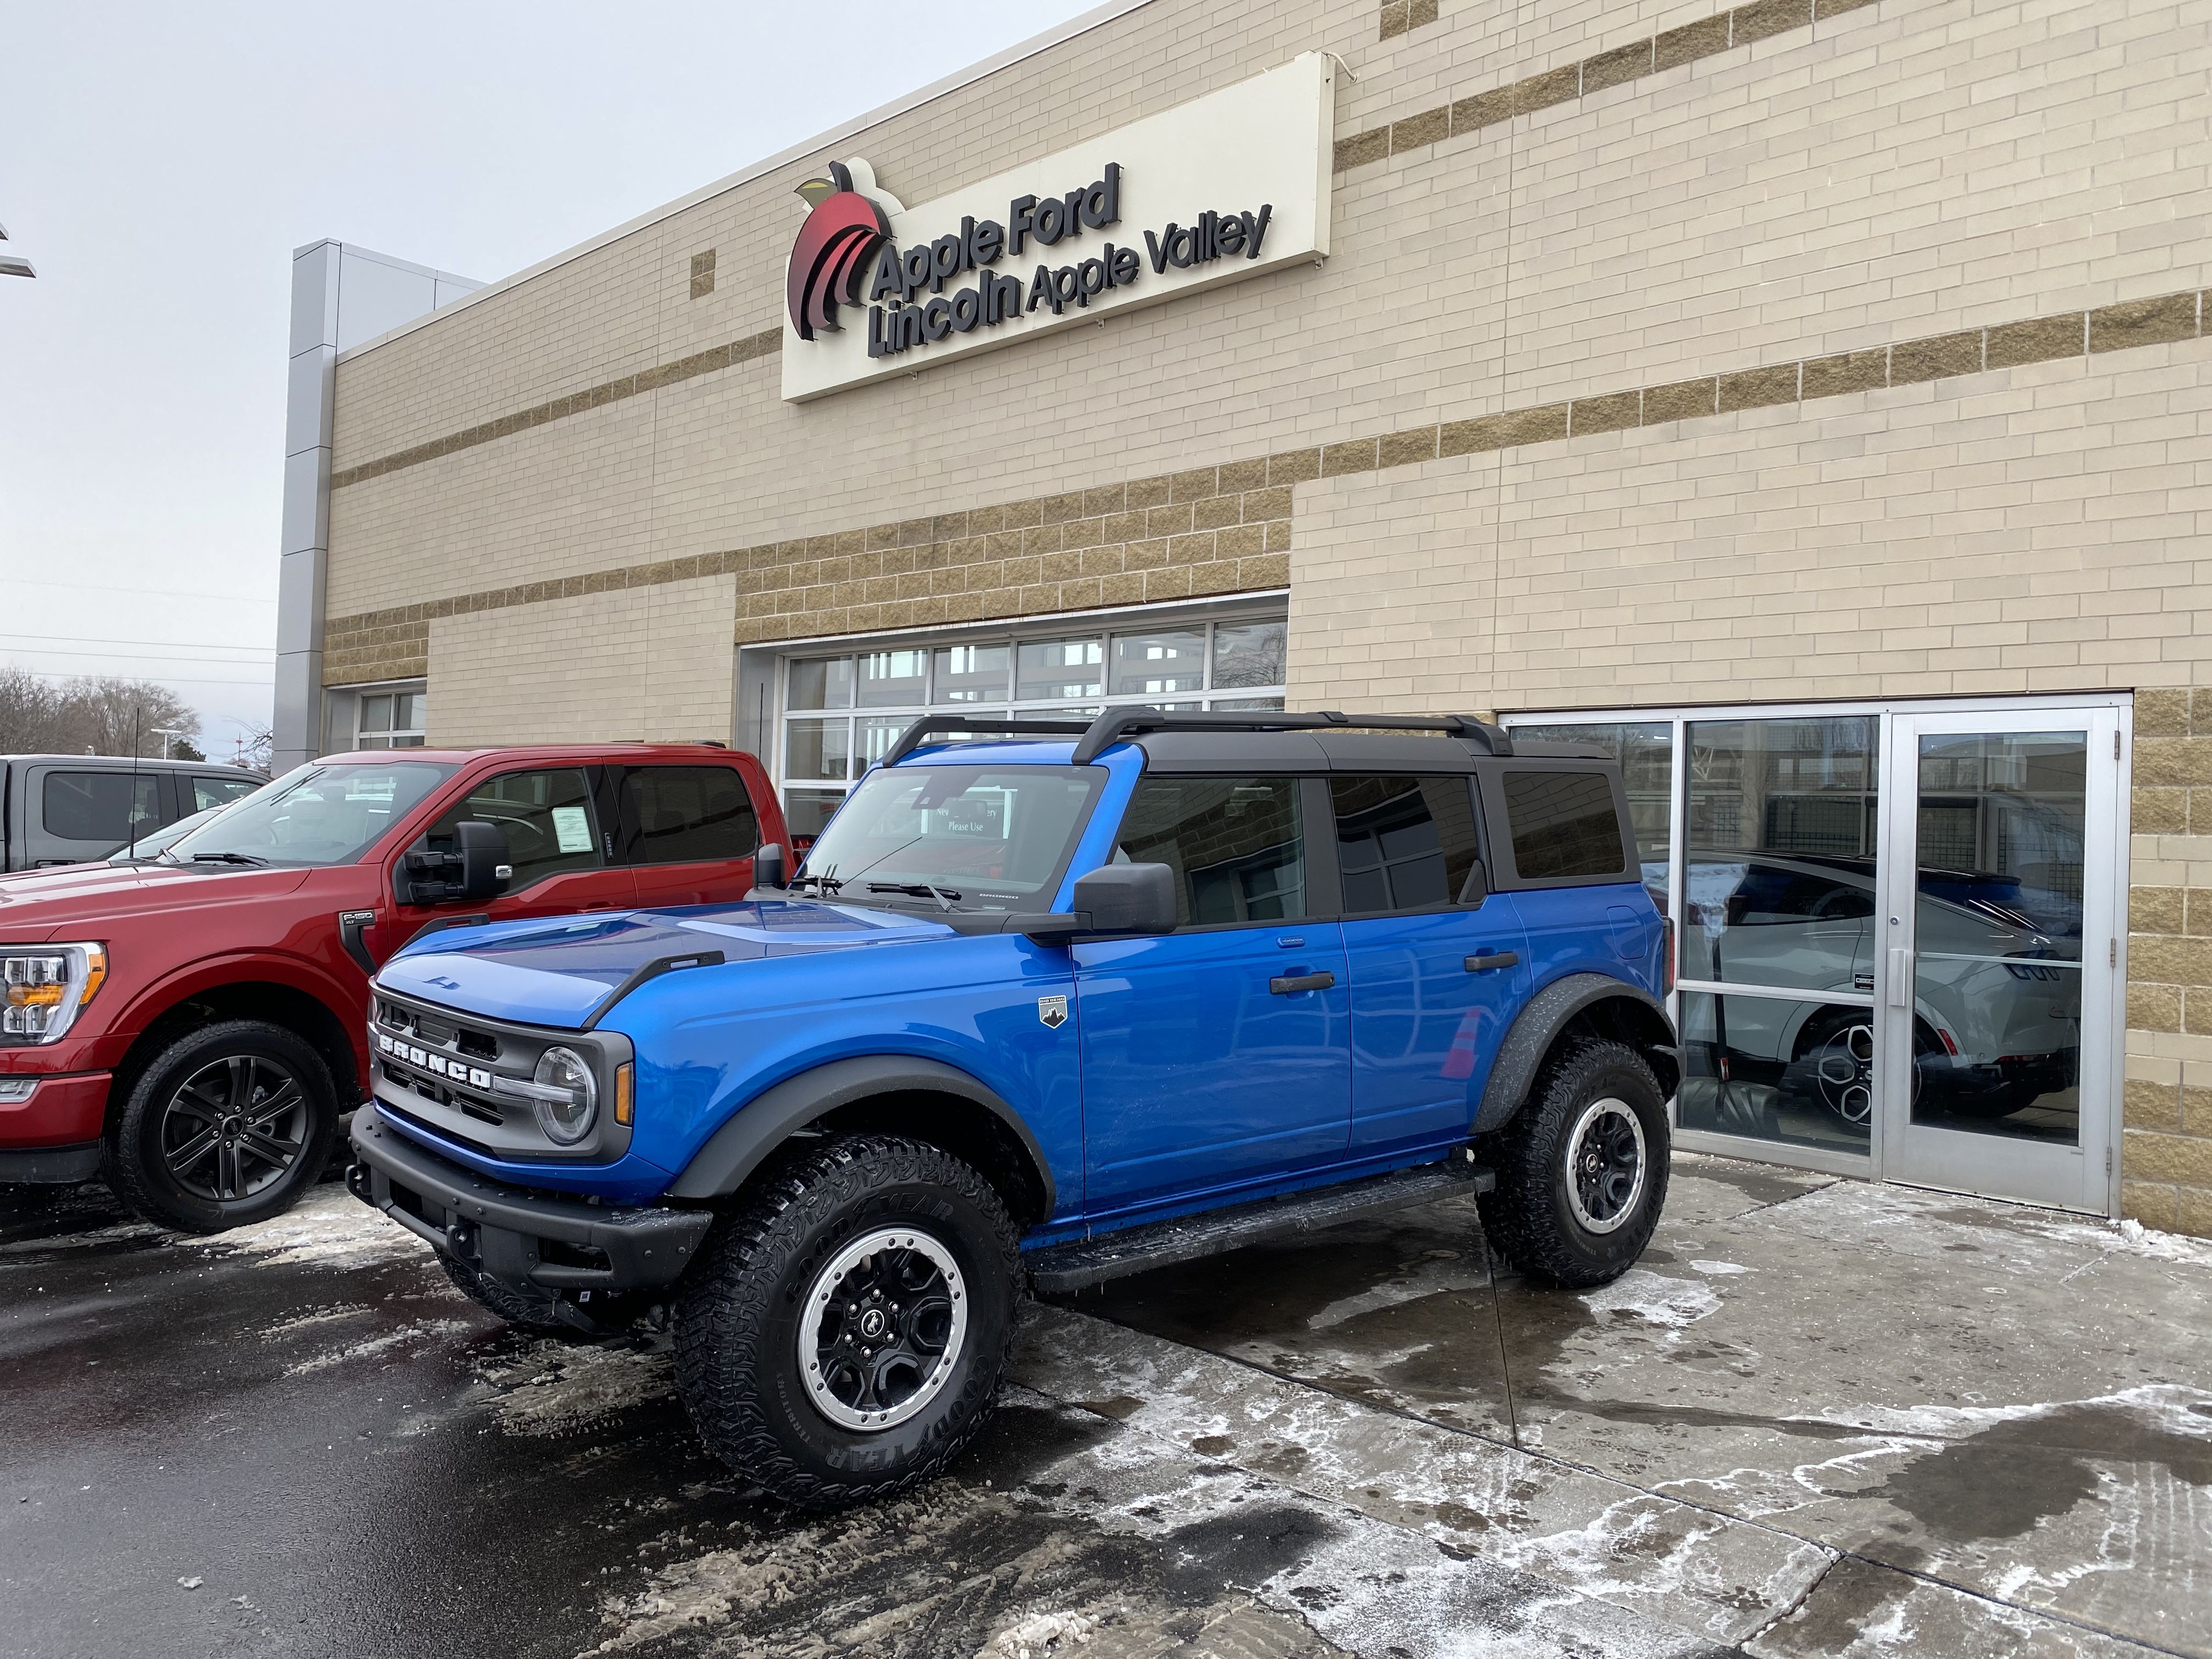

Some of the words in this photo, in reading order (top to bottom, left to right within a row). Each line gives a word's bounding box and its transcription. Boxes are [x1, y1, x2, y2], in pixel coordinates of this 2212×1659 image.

[869, 215, 1004, 303] Apple
[1008, 162, 1120, 256] Ford
[868, 269, 1021, 358] Lincoln
[1025, 242, 1141, 315] Apple
[1143, 204, 1273, 274] Valley
[949, 821, 969, 831] Please
[970, 822, 984, 832] Use
[343, 912, 373, 921] F-150
[379, 1034, 490, 1088] BRONCO
